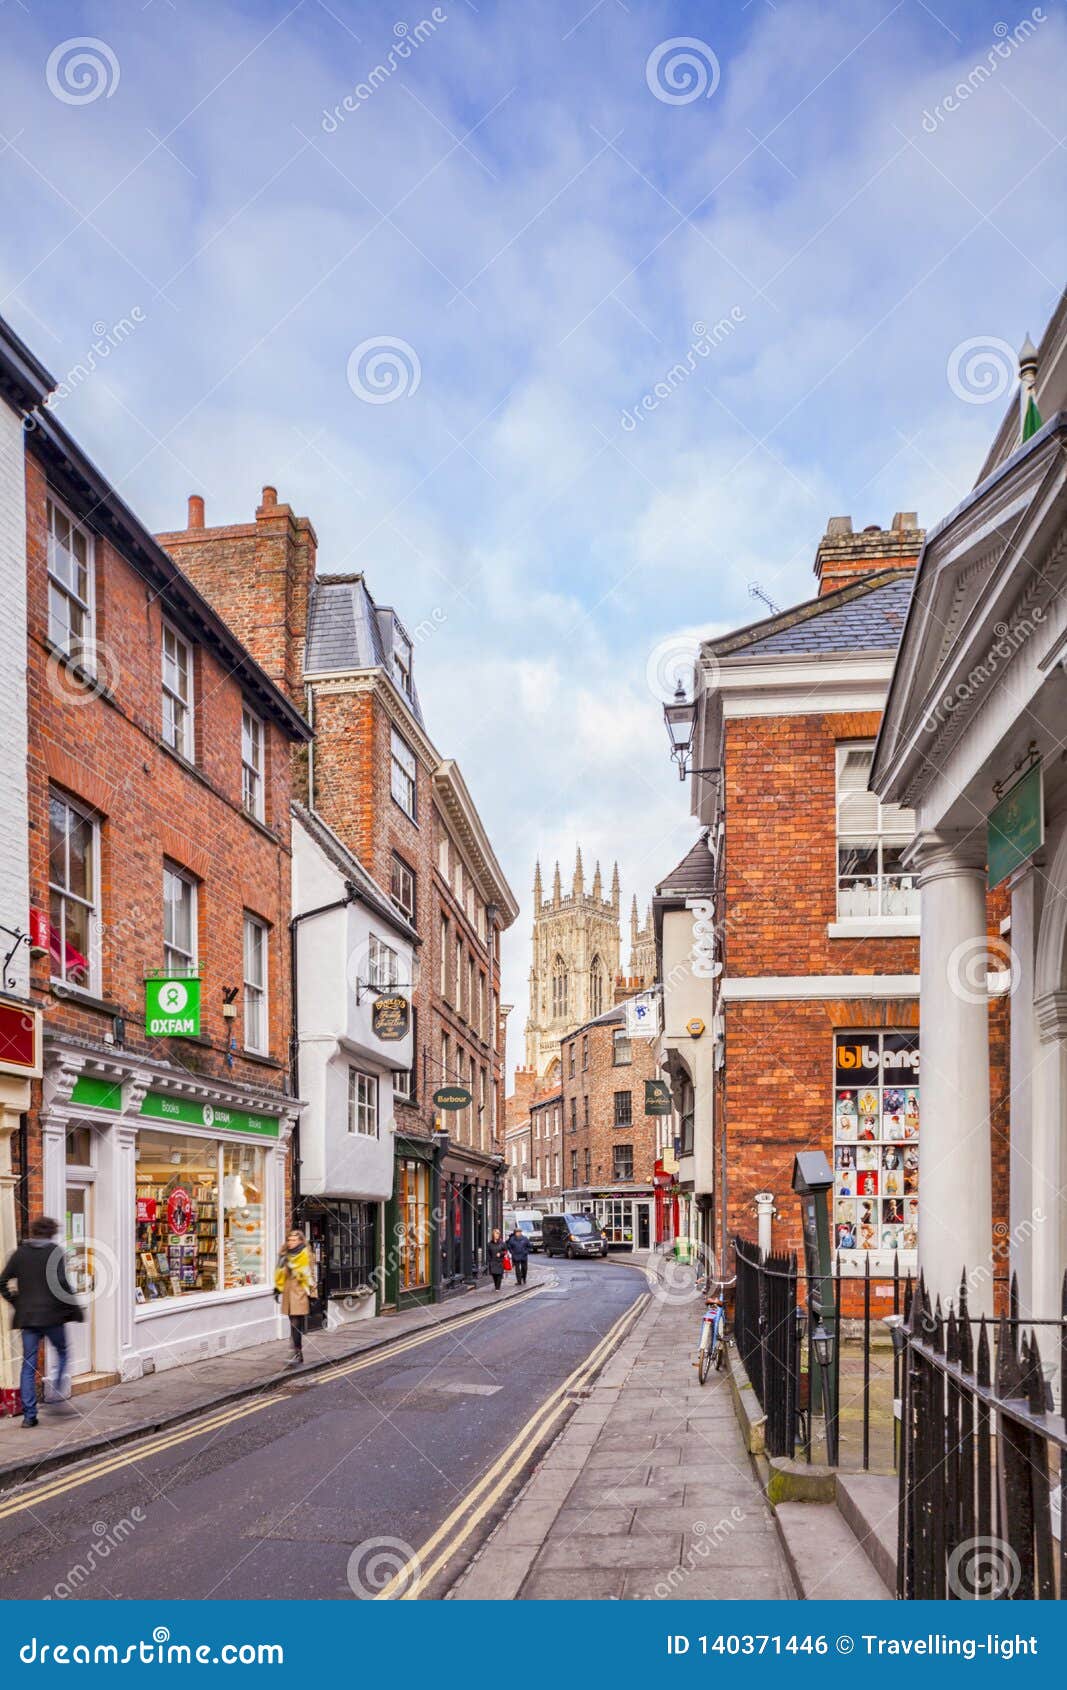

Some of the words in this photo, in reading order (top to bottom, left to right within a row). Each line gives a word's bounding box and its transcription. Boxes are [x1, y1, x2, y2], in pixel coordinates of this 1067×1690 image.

[150, 1019, 194, 1034] OXFAM
[437, 1095, 467, 1103] Barbour
[161, 1100, 180, 1115] Books
[214, 1111, 230, 1123] OXFAM
